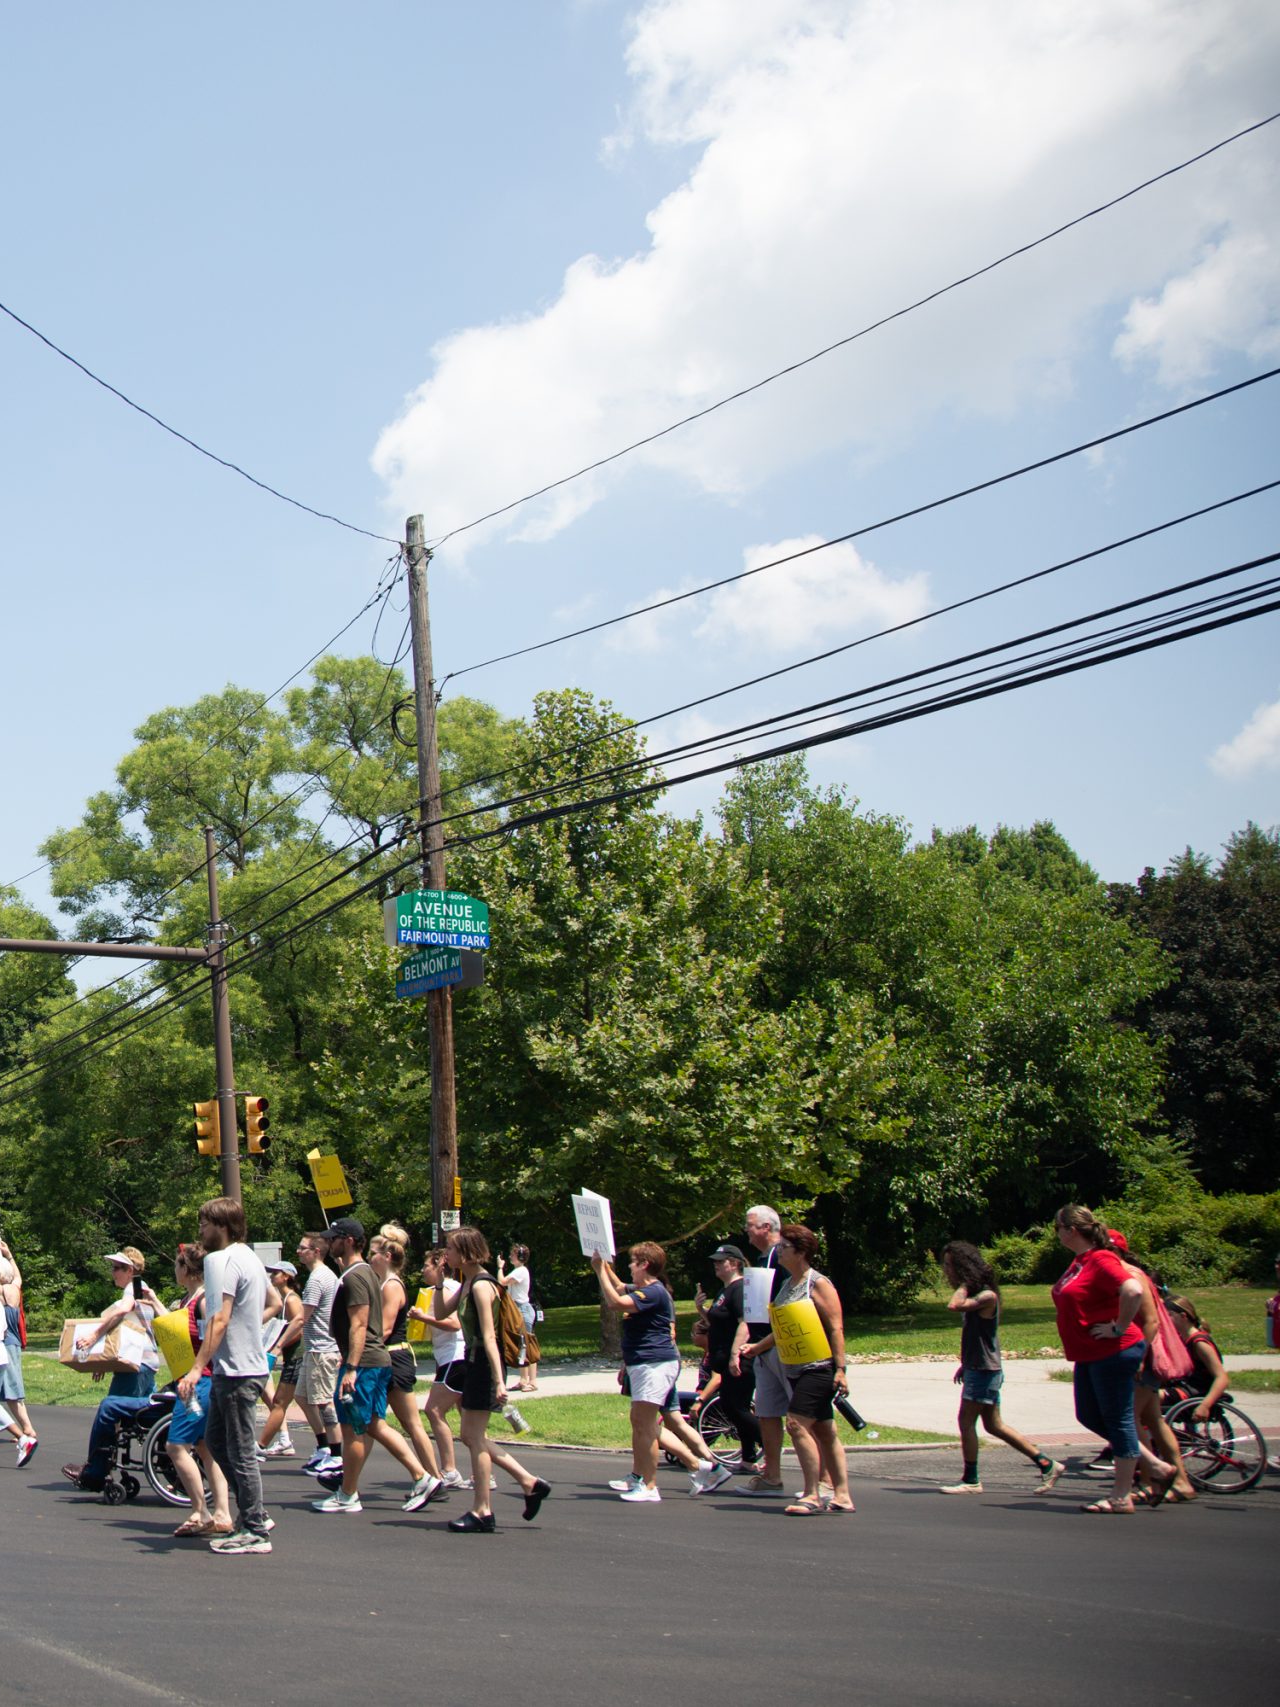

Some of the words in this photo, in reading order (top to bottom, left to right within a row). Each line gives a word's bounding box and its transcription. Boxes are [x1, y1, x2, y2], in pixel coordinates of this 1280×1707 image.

[413, 902, 473, 918] AVENUE
[400, 914, 413, 927] OF
[416, 916, 436, 930] THE
[439, 918, 486, 933] REPUBLIC
[401, 930, 458, 945] FAIRMOUNT
[461, 934, 486, 947] PARK
[404, 955, 448, 981] BELMONT
[577, 1203, 600, 1217] REPAIR
[585, 1220, 599, 1234] AND
